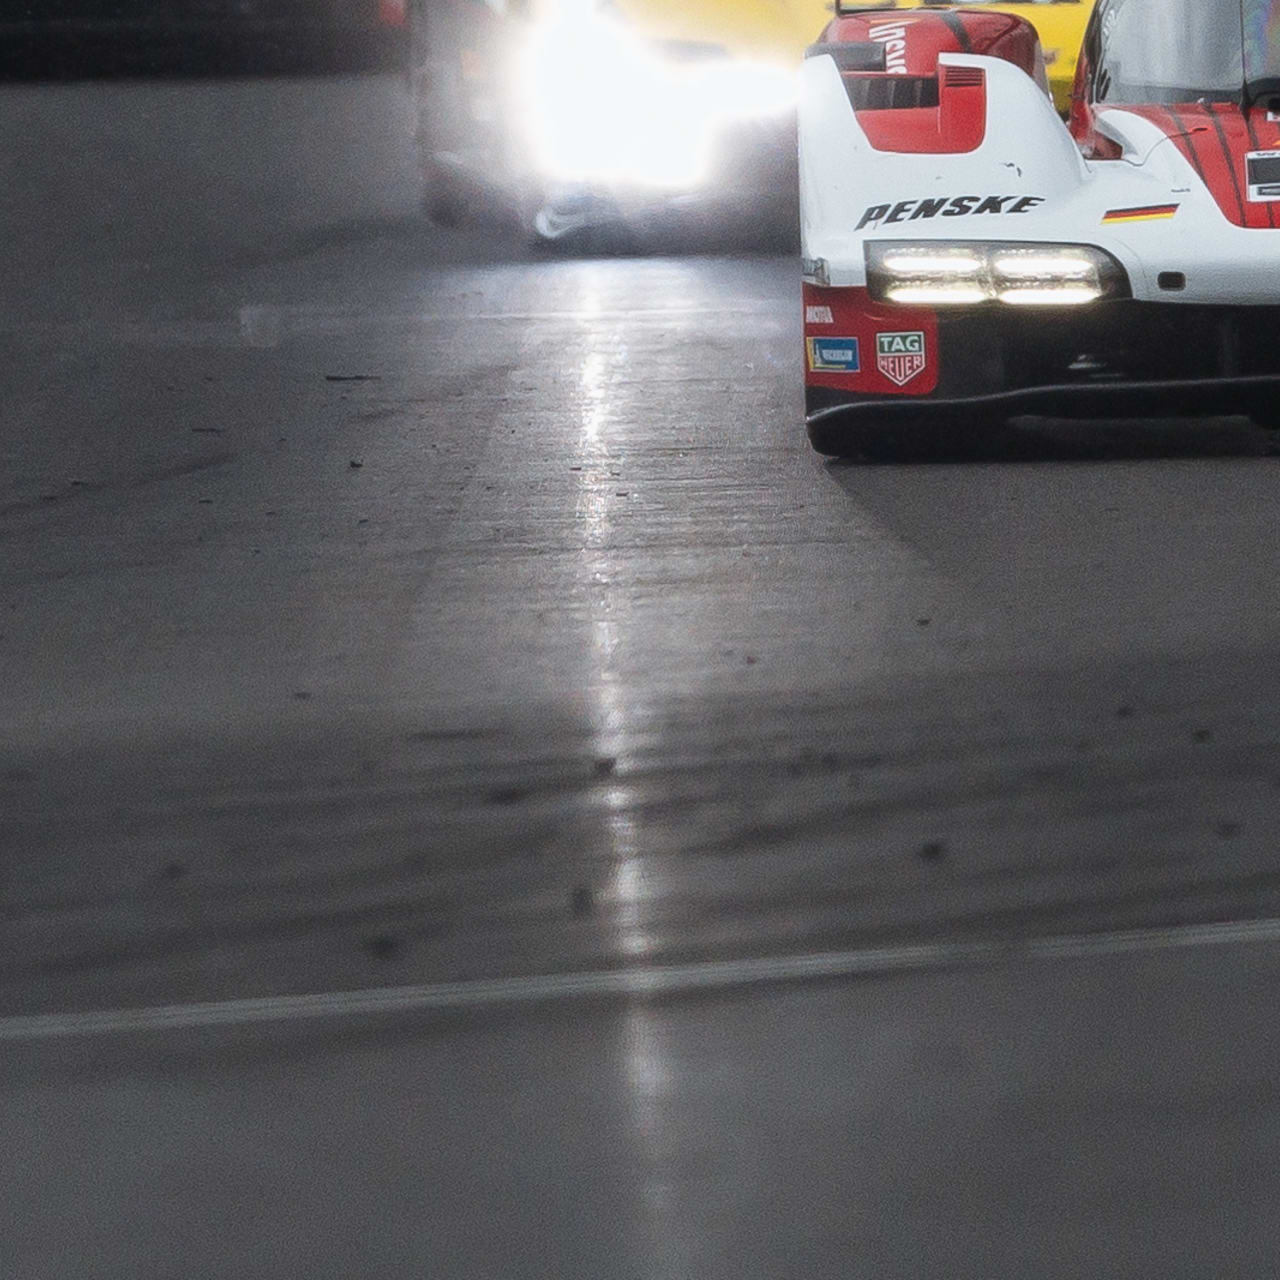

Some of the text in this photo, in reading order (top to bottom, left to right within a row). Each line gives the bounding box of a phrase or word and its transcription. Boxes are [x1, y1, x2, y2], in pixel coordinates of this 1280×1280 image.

[854, 195, 1046, 231] PENSKE
[880, 335, 920, 352] TAG
[880, 355, 922, 381] HEUER
